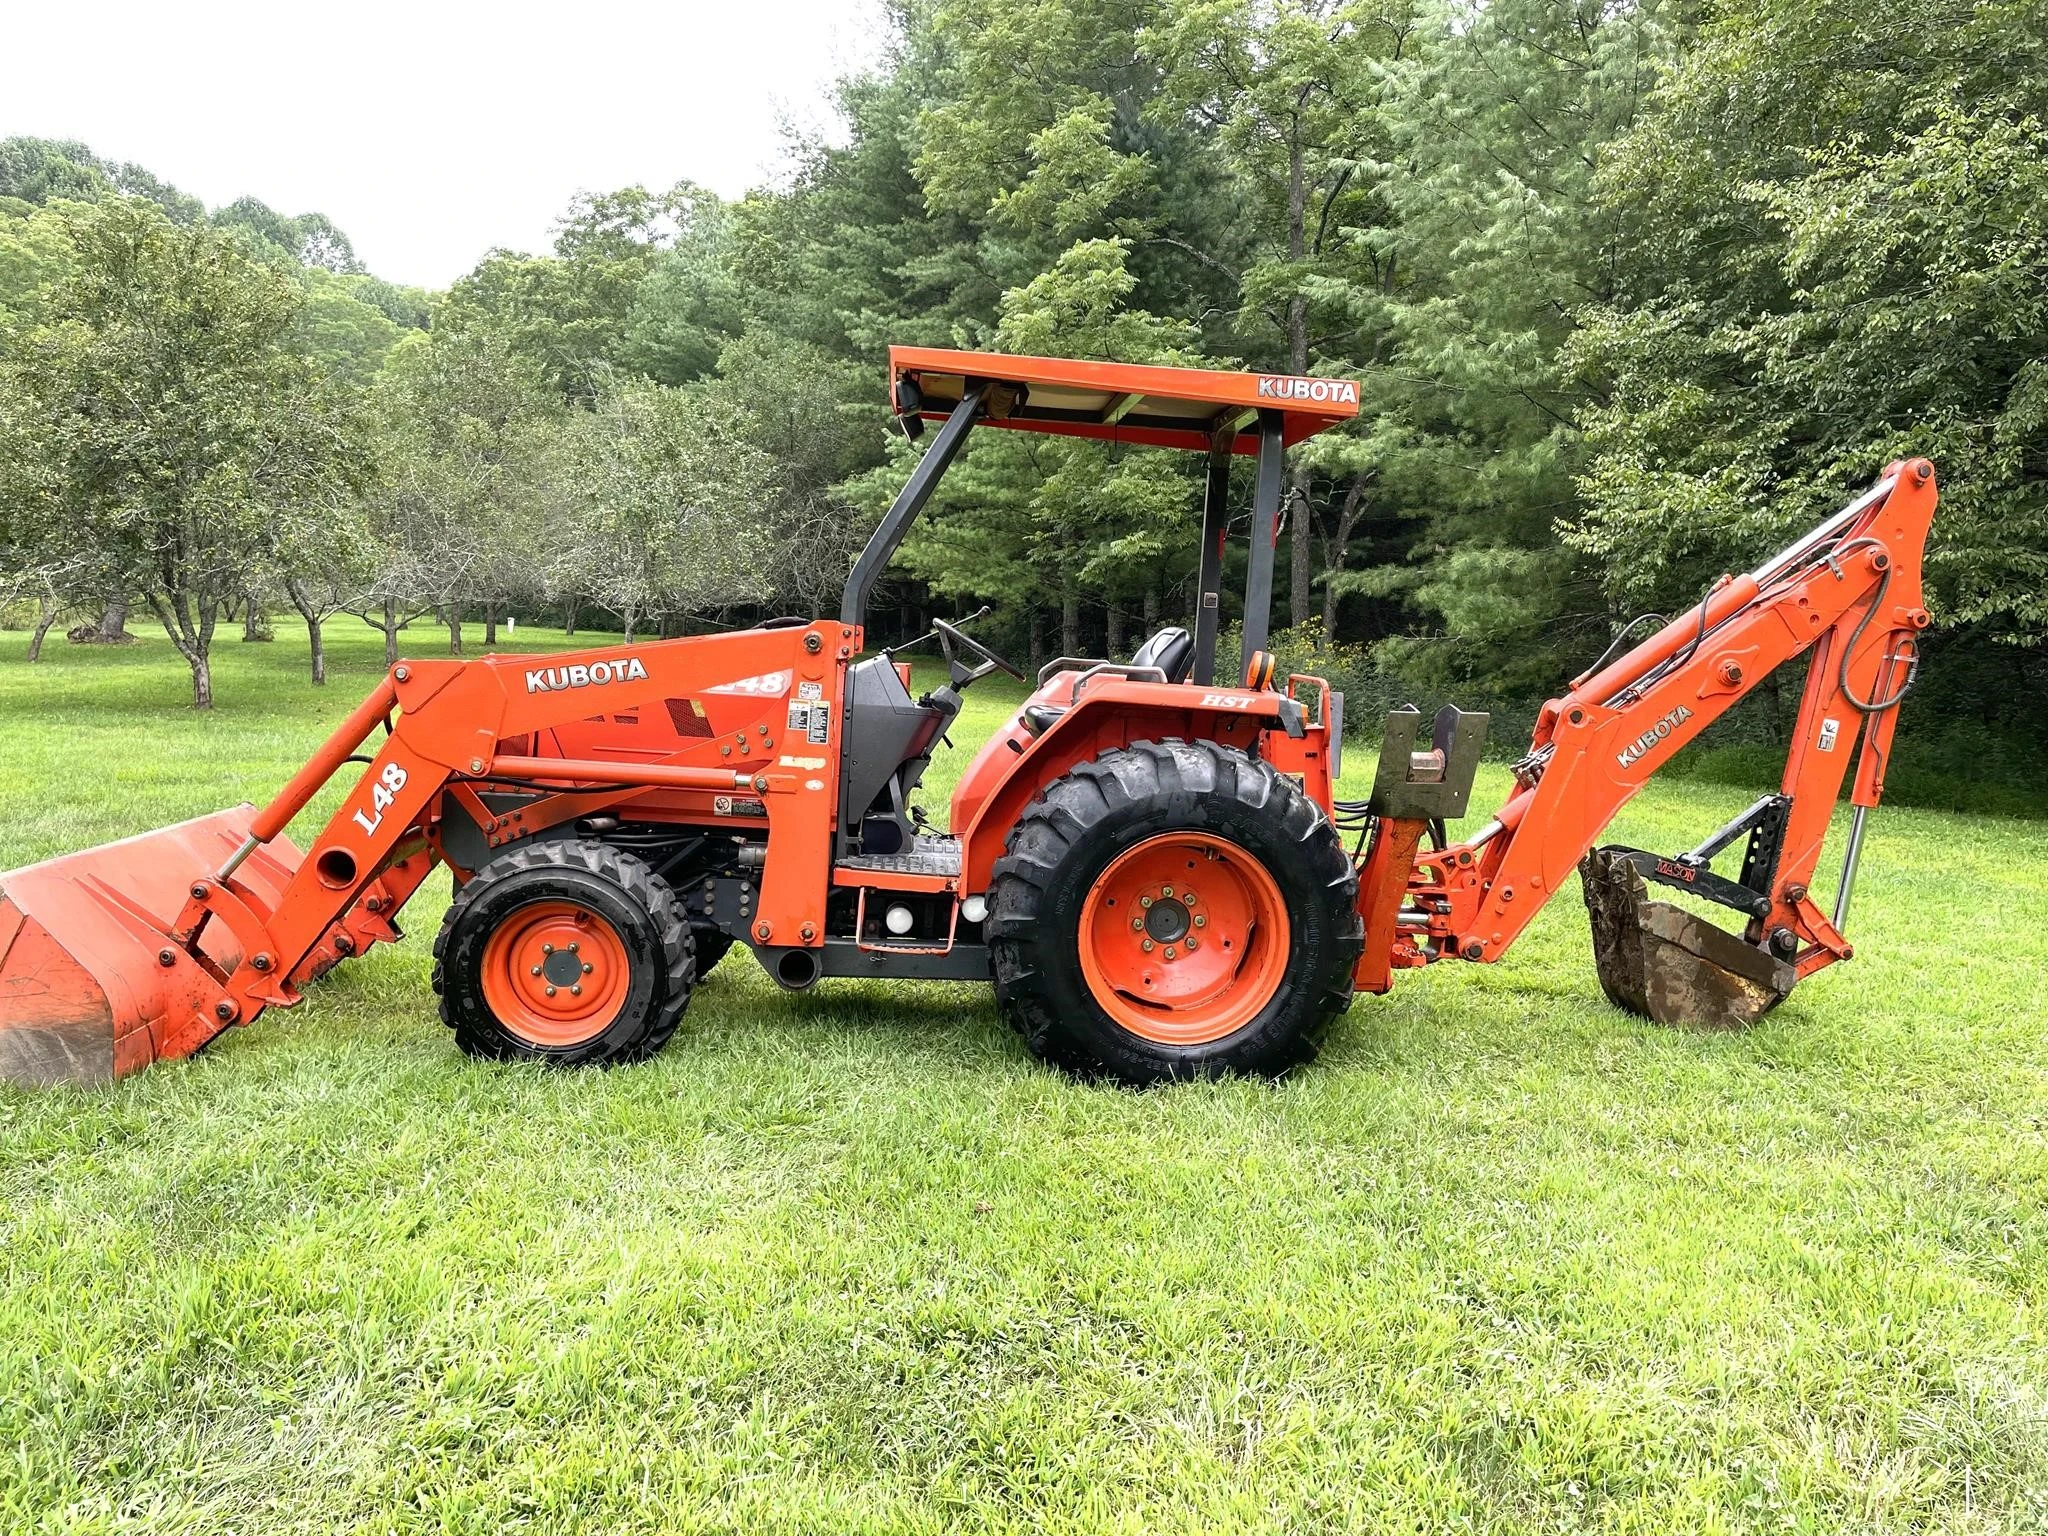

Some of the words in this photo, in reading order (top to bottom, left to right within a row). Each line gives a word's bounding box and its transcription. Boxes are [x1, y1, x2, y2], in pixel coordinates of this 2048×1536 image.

[1258, 376, 1357, 404] KUBOTA
[525, 657, 649, 694] KUBOTA
[1199, 694, 1257, 709] HST
[1616, 704, 1695, 769] KUBOTA
[352, 761, 408, 837] L48
[1657, 860, 1696, 882] MASON
